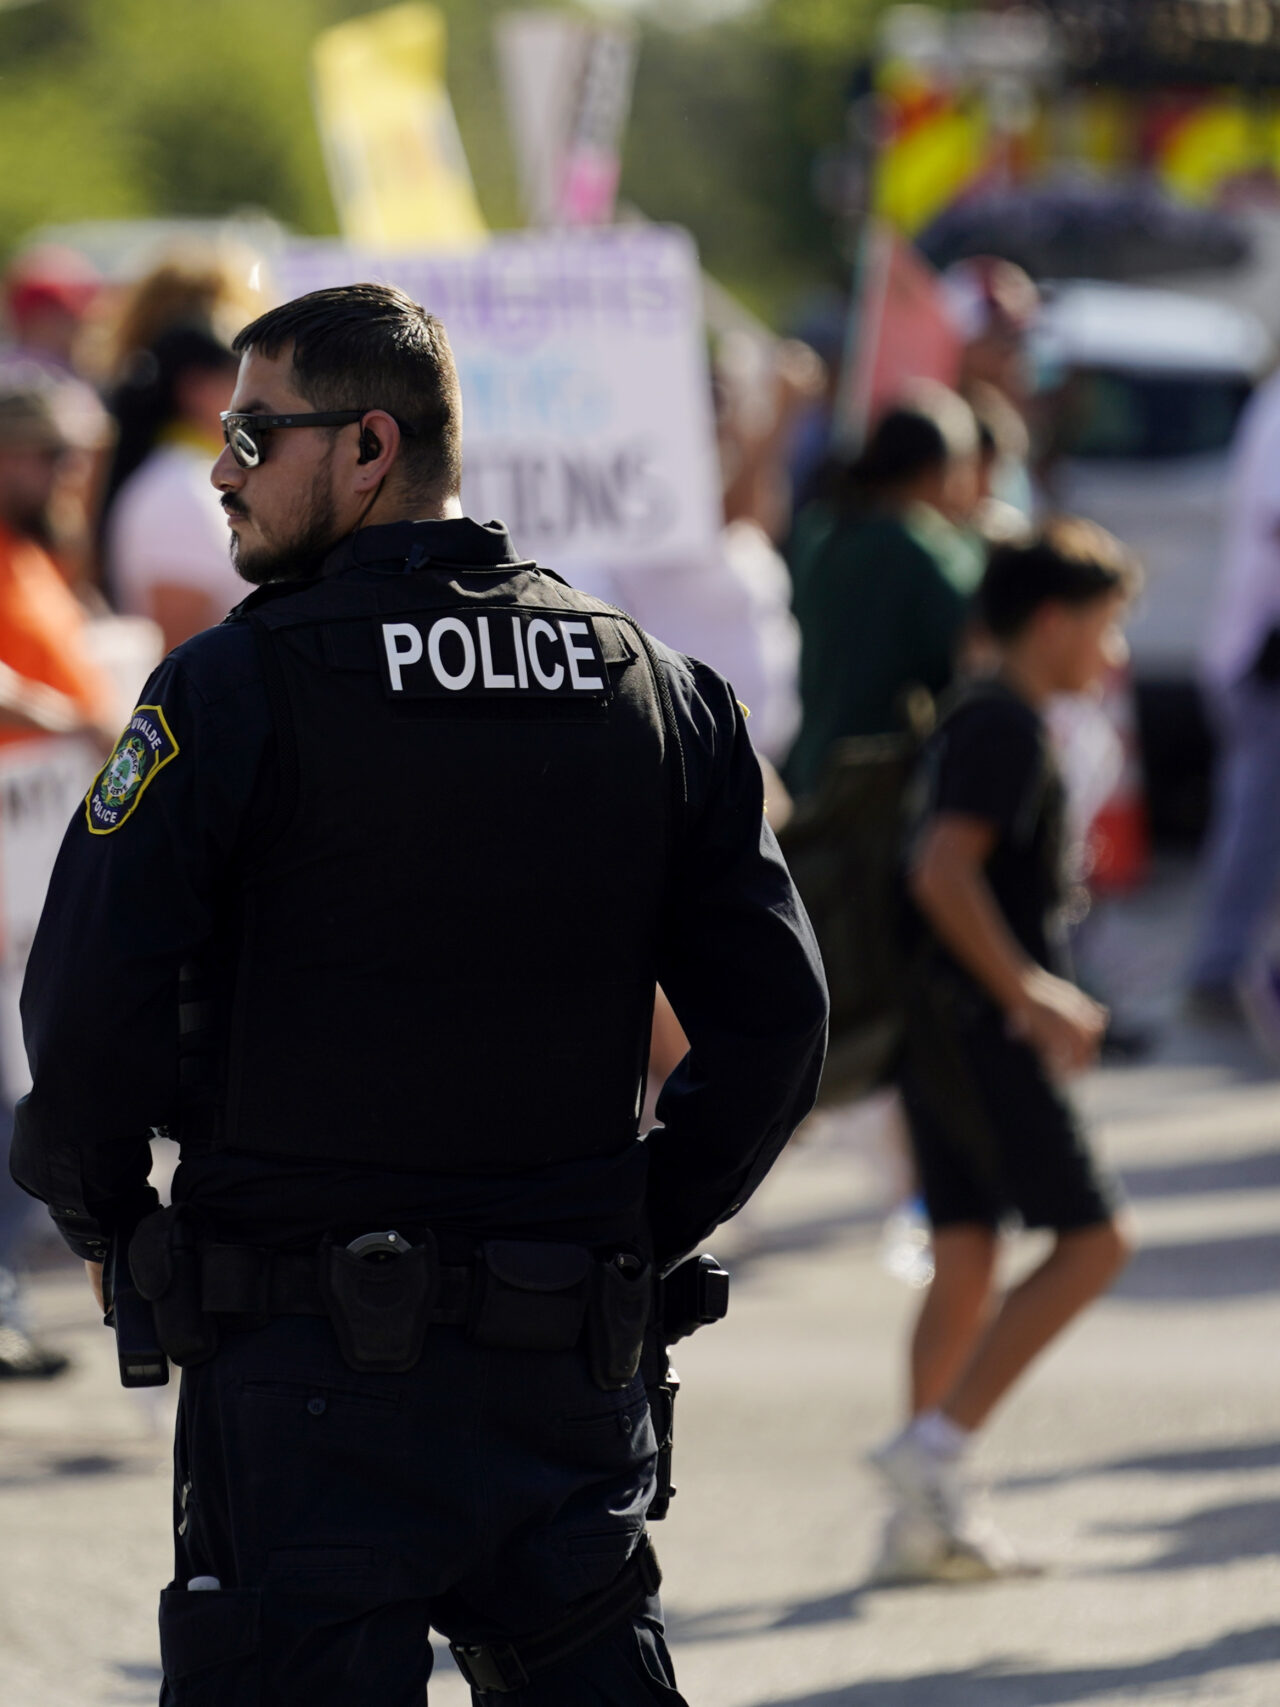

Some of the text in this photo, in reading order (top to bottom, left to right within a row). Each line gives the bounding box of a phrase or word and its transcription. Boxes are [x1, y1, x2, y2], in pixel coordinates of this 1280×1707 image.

[382, 616, 604, 691] POLICE
[131, 716, 162, 750] UVALDE
[91, 793, 118, 824] POLICE
